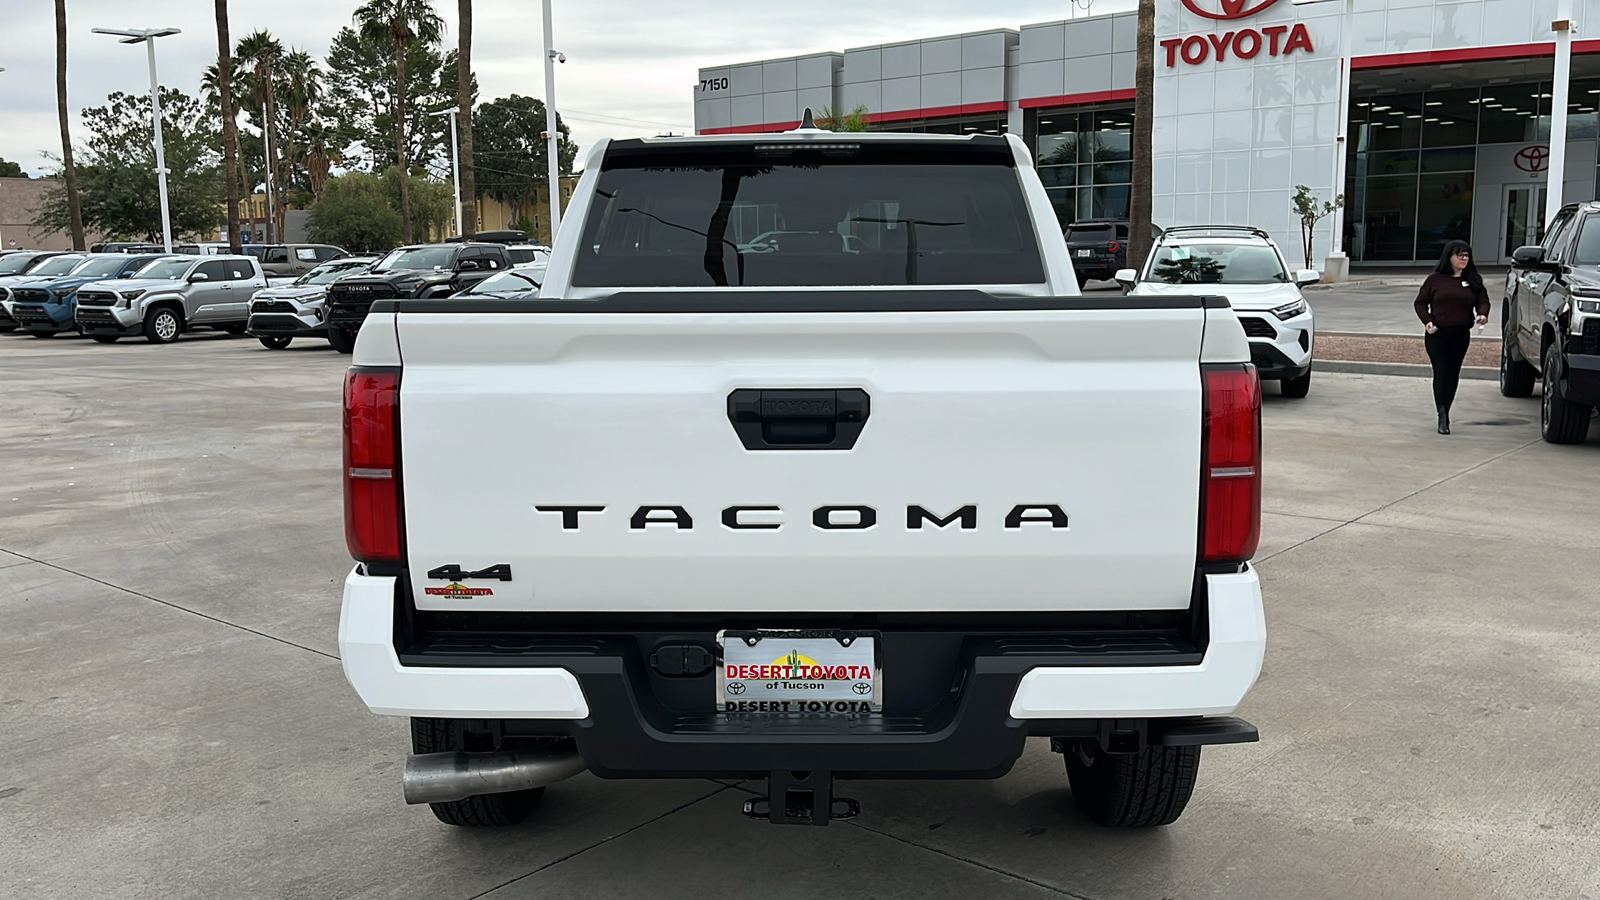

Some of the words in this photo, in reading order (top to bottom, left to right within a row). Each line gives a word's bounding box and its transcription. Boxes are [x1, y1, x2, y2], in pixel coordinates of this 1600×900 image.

[1160, 23, 1314, 67] TOYOTA
[701, 77, 728, 92] 7150
[766, 400, 832, 413] TOYOTA
[534, 505, 1068, 529] TACOMA
[726, 665, 793, 679] DESERT
[799, 665, 871, 679] TOYOTA
[766, 682, 778, 690] of
[781, 681, 825, 690] Tucson
[725, 701, 790, 712] DESERT
[798, 701, 871, 712] TOYOTA
